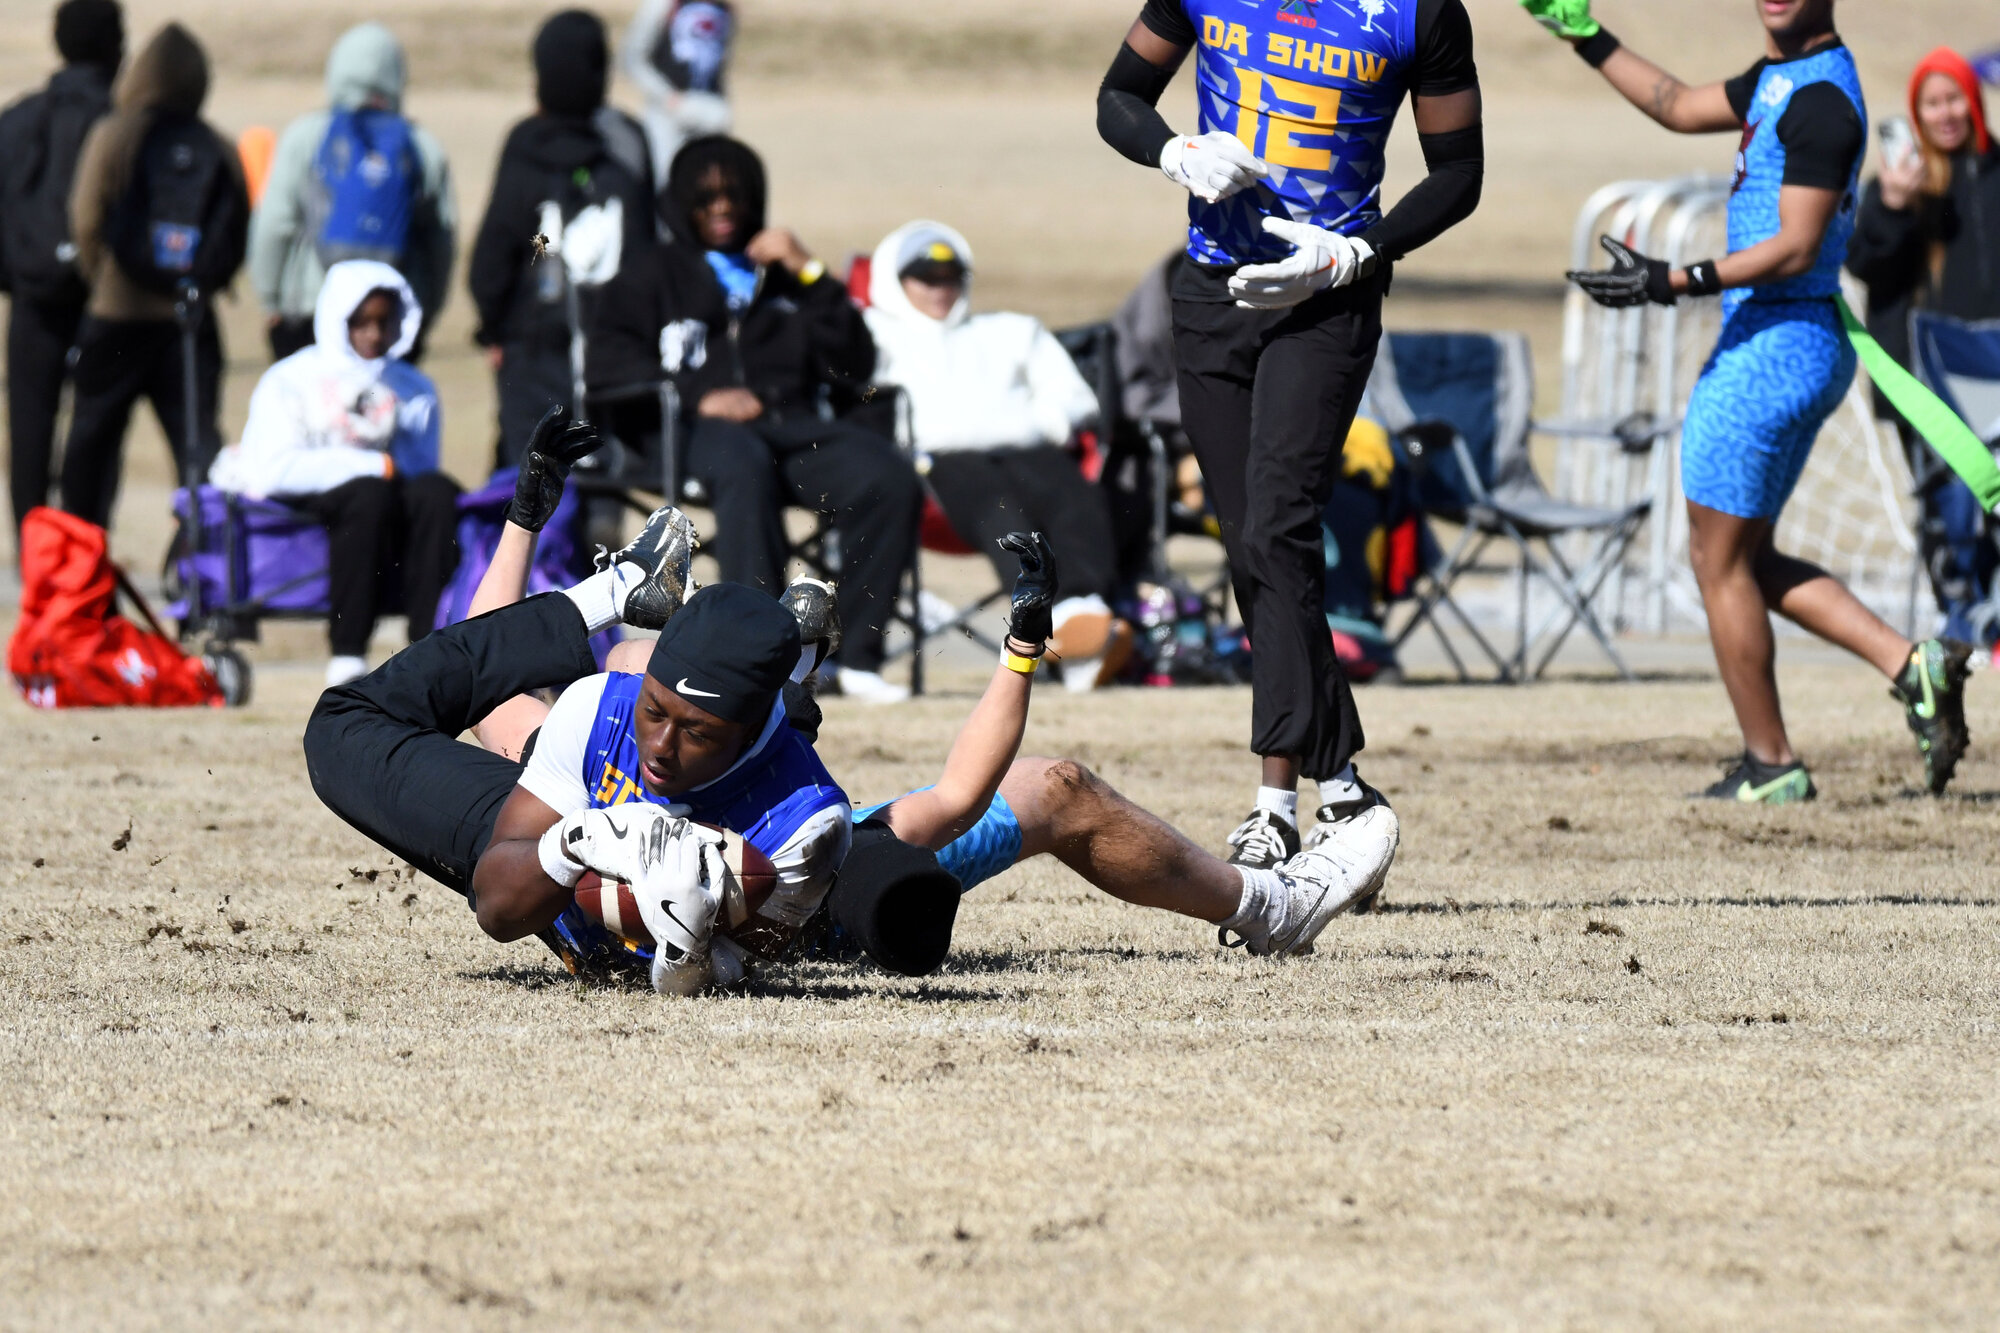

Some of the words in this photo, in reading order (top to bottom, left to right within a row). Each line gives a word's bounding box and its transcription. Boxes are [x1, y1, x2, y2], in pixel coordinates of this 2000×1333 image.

[1203, 16, 1248, 56] DA
[1266, 32, 1388, 82] SHOW
[1276, 11, 1317, 29] UNITED
[1233, 66, 1342, 171] 12
